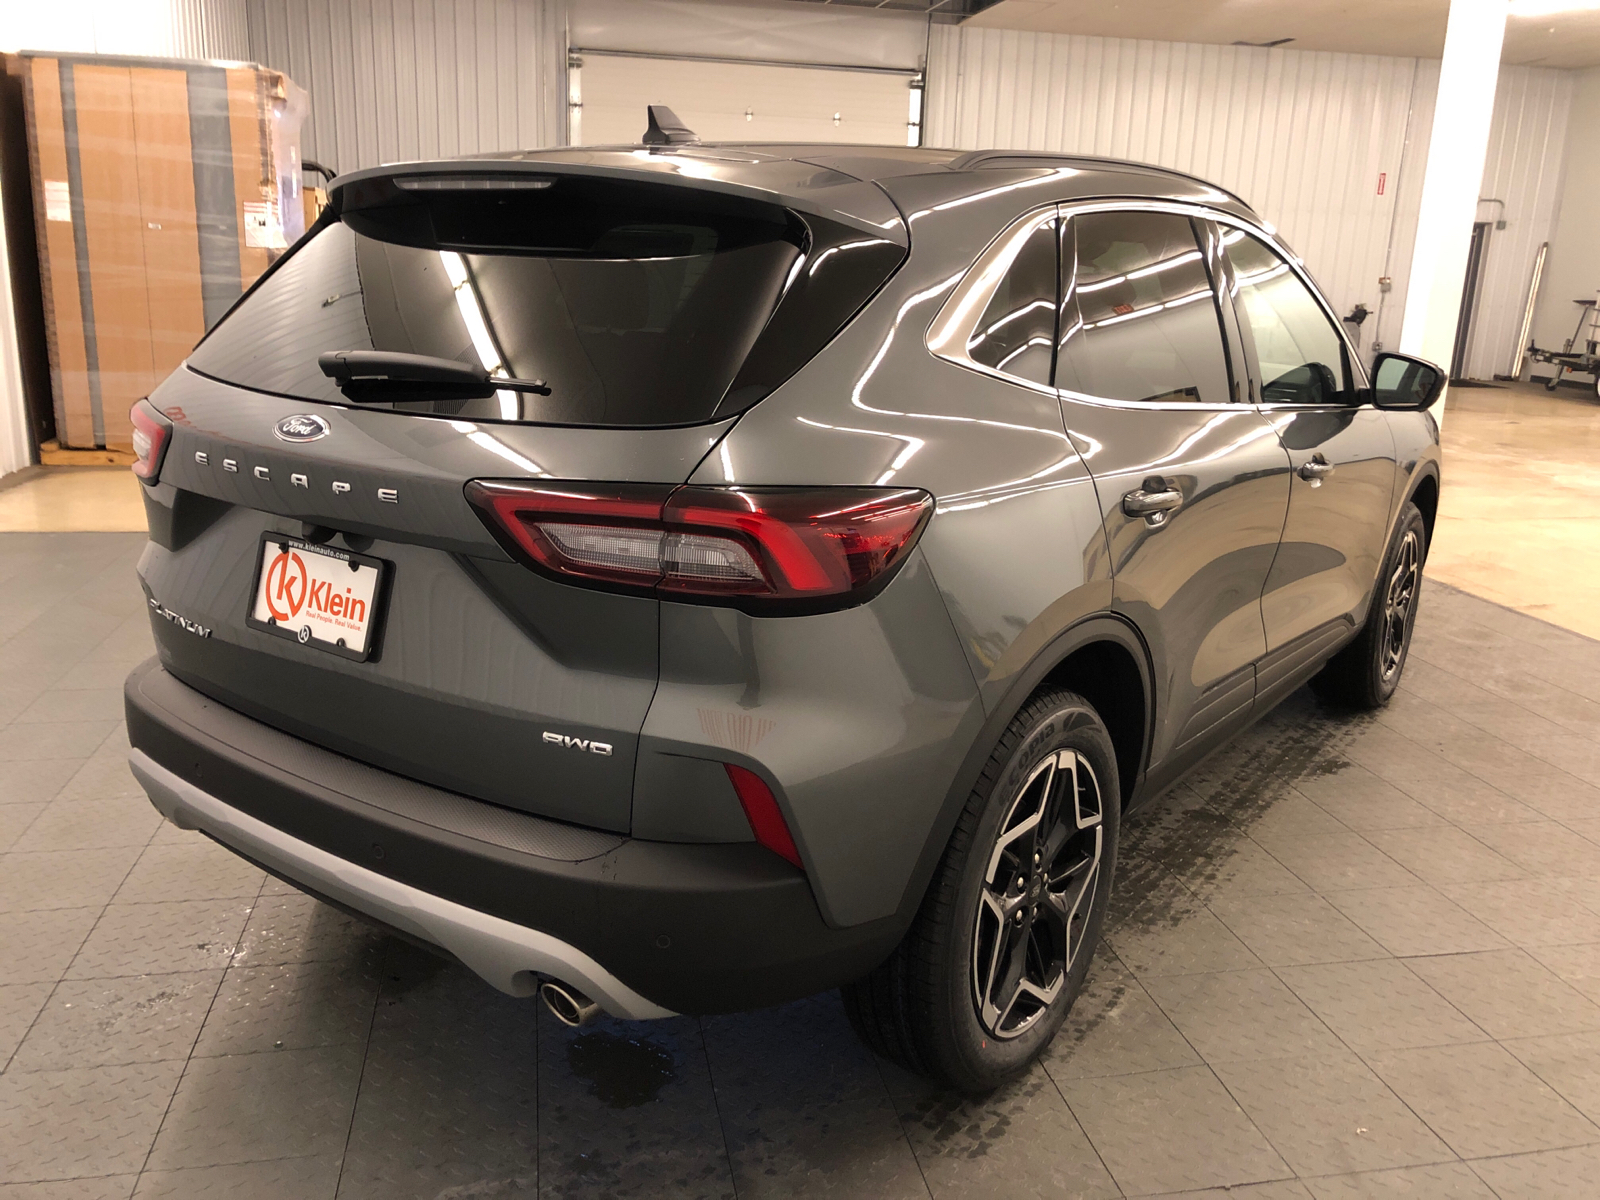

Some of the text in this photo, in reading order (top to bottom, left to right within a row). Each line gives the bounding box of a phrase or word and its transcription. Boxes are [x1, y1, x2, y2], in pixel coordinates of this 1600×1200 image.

[194, 451, 399, 504] ESCAPE
[288, 540, 350, 561] www.kleinauto.com
[307, 578, 366, 623] Klein
[305, 610, 317, 619] Real
[334, 618, 346, 628] Real
[542, 730, 614, 757] AWD
